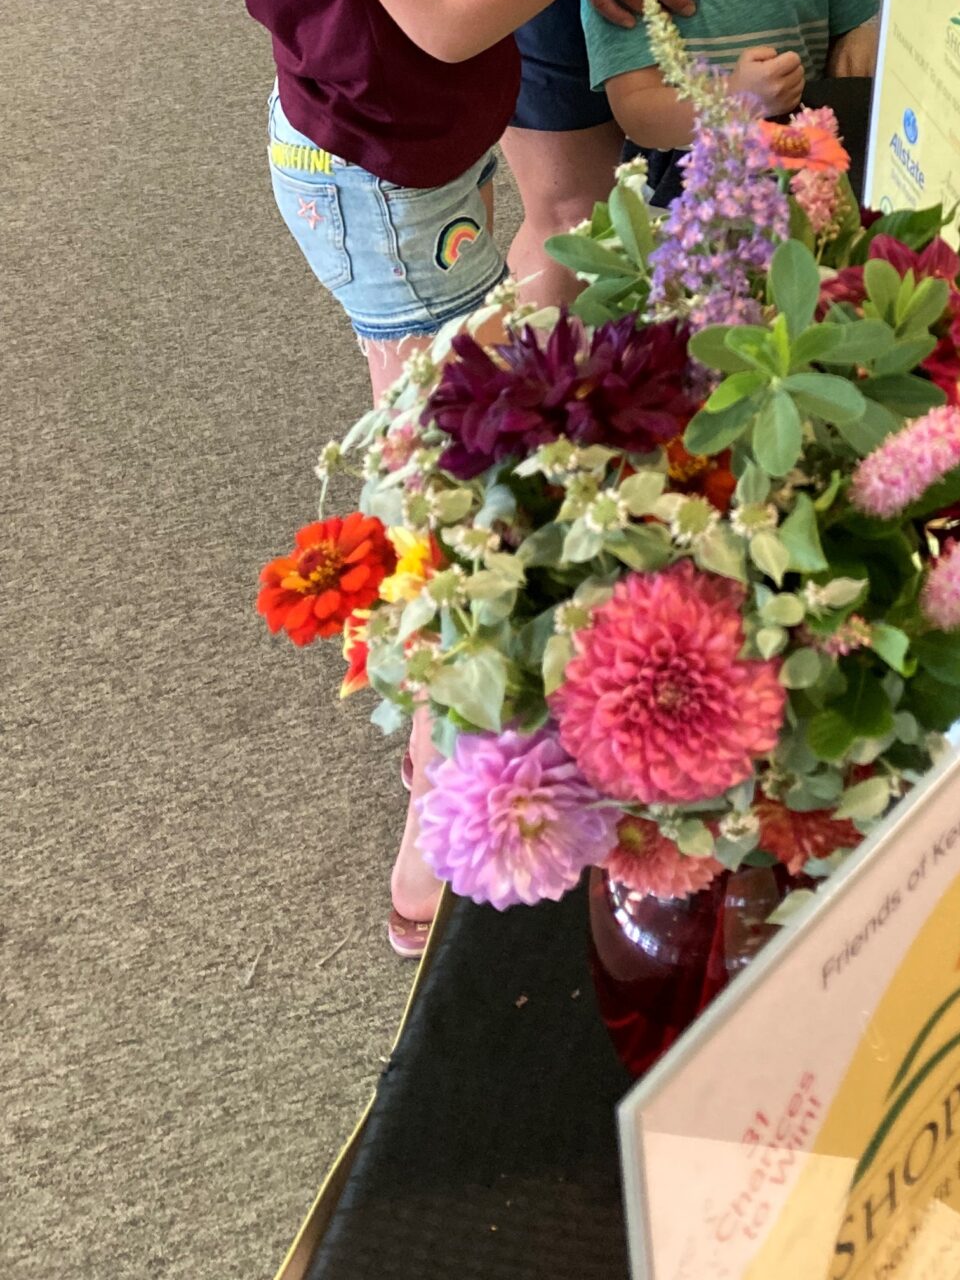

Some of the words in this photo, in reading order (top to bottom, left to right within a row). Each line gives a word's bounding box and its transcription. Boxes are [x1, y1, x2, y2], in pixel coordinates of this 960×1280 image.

[889, 132, 925, 190] Allstate
[820, 893, 901, 991] Friends
[906, 853, 929, 894] of
[715, 1072, 815, 1243] Chances
[742, 1110, 770, 1160] 31
[742, 1200, 771, 1241] to
[769, 1096, 822, 1185] Win!
